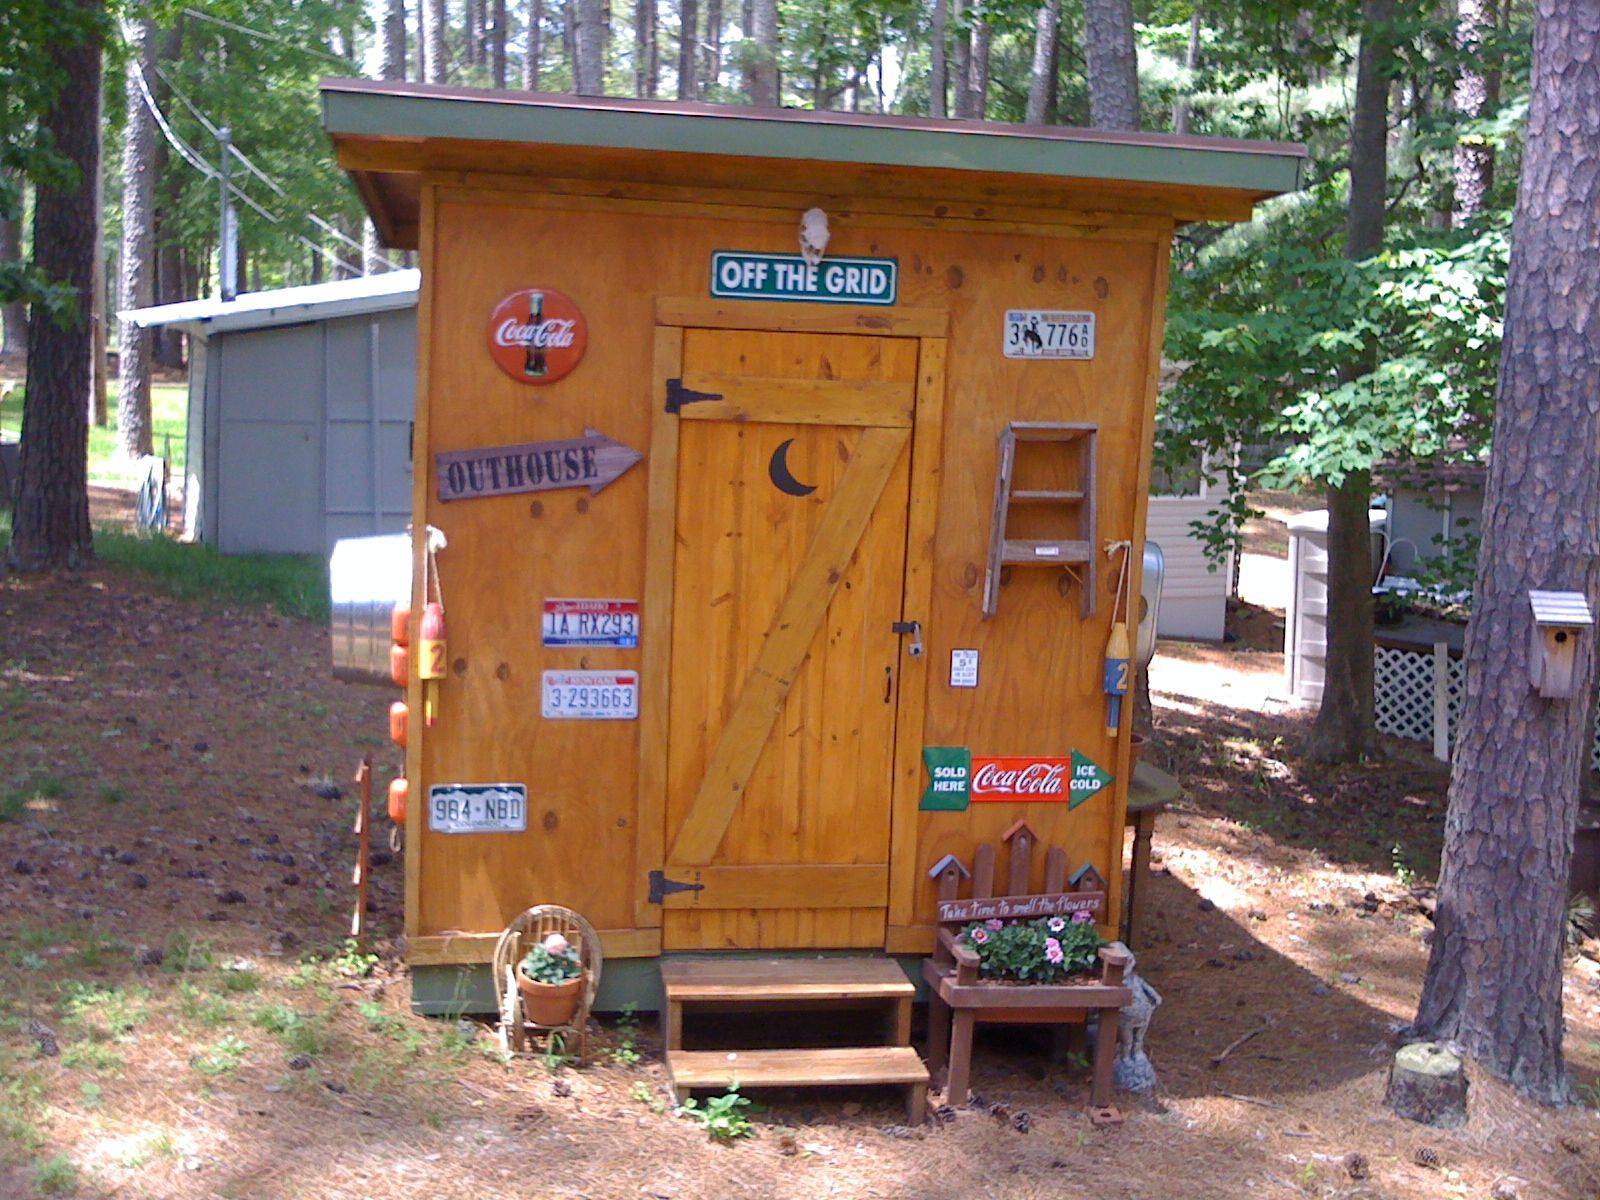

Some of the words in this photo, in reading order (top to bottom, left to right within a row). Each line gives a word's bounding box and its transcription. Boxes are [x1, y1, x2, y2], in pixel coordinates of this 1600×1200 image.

[720, 260, 768, 290] OFF
[774, 263, 819, 292] THE
[825, 265, 887, 295] GRID
[1046, 323, 1078, 347] 776
[448, 445, 598, 495] OUTHOUSE
[578, 612, 634, 636] RX293
[430, 644, 446, 673] 2
[1116, 663, 1128, 690] 2
[934, 766, 966, 778] SOLD
[972, 763, 1066, 794] Coca-Cola
[1076, 765, 1096, 776] ICE
[934, 780, 966, 792] HERE
[1069, 778, 1101, 790] COLD
[939, 904, 967, 920] Take
[999, 899, 1009, 914] to
[1013, 897, 1036, 914] smell
[1038, 897, 1055, 913] the
[1055, 895, 1099, 912] flowers
